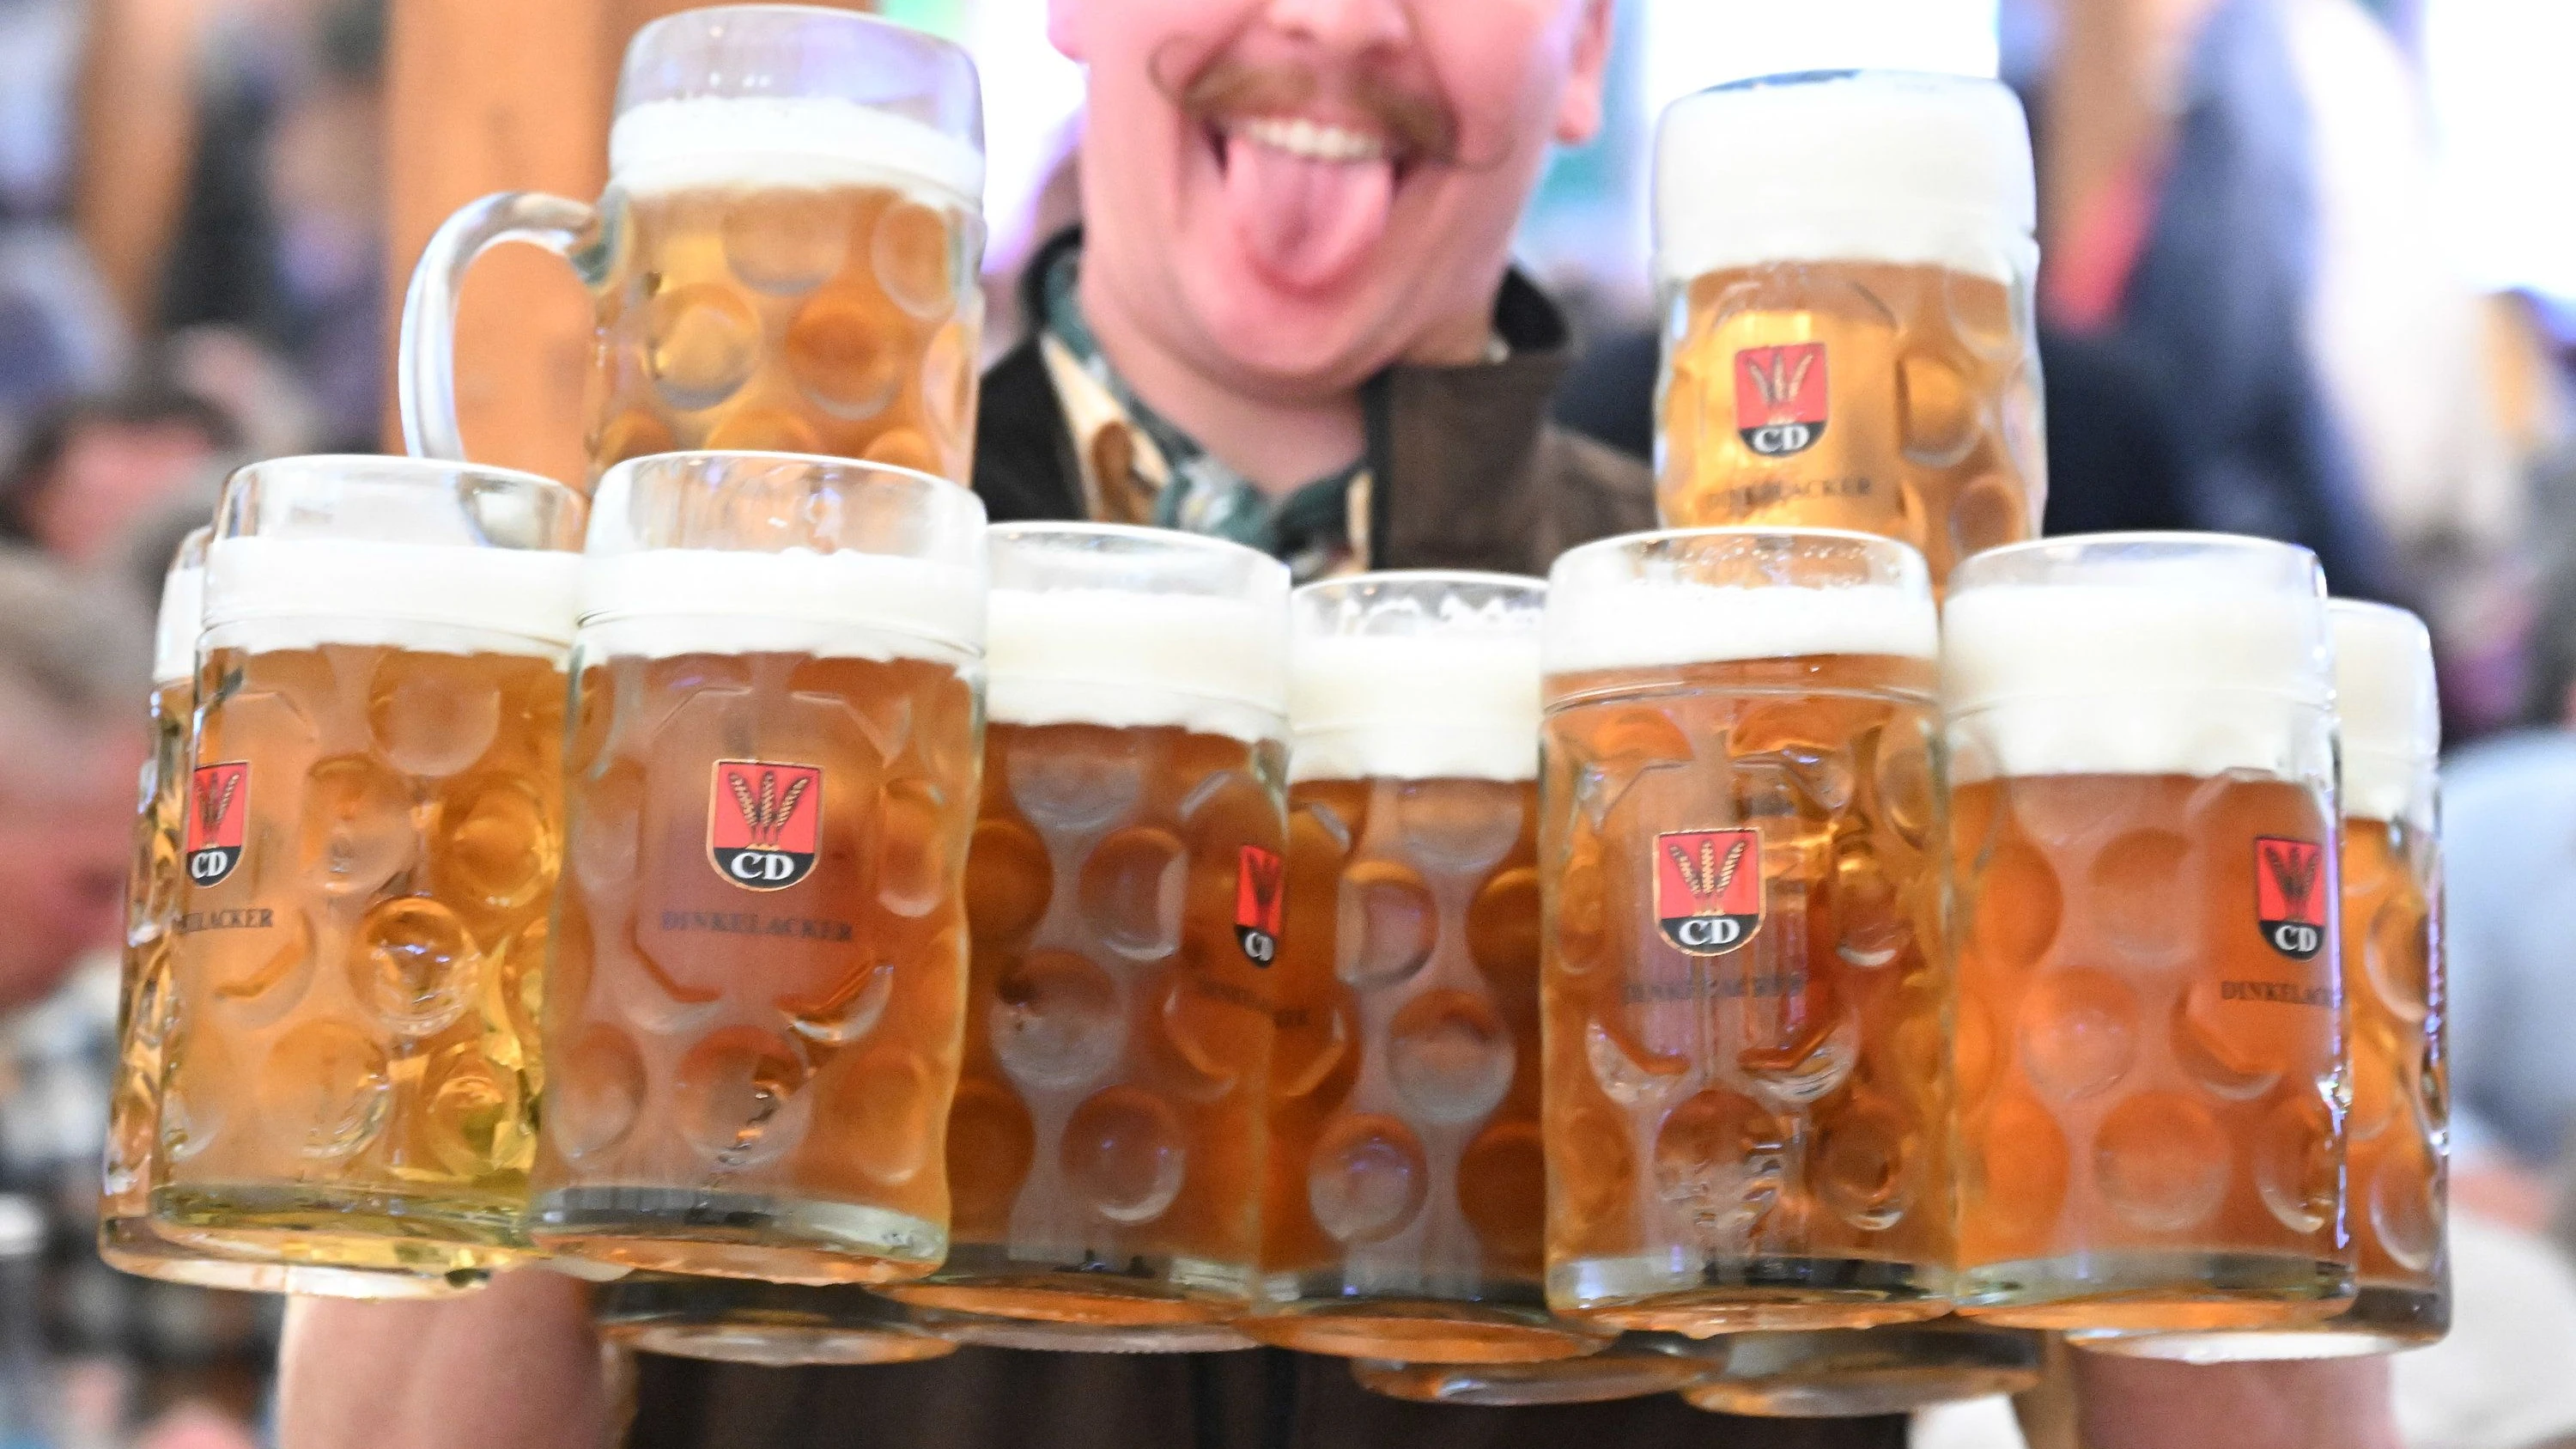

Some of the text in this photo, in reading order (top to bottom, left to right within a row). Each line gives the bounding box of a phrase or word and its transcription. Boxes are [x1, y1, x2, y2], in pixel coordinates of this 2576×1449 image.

[1753, 424, 1811, 453] CD
[191, 850, 229, 880] CD
[730, 850, 795, 880] CD
[1679, 917, 1741, 946] CD
[2275, 923, 2318, 953] CD
